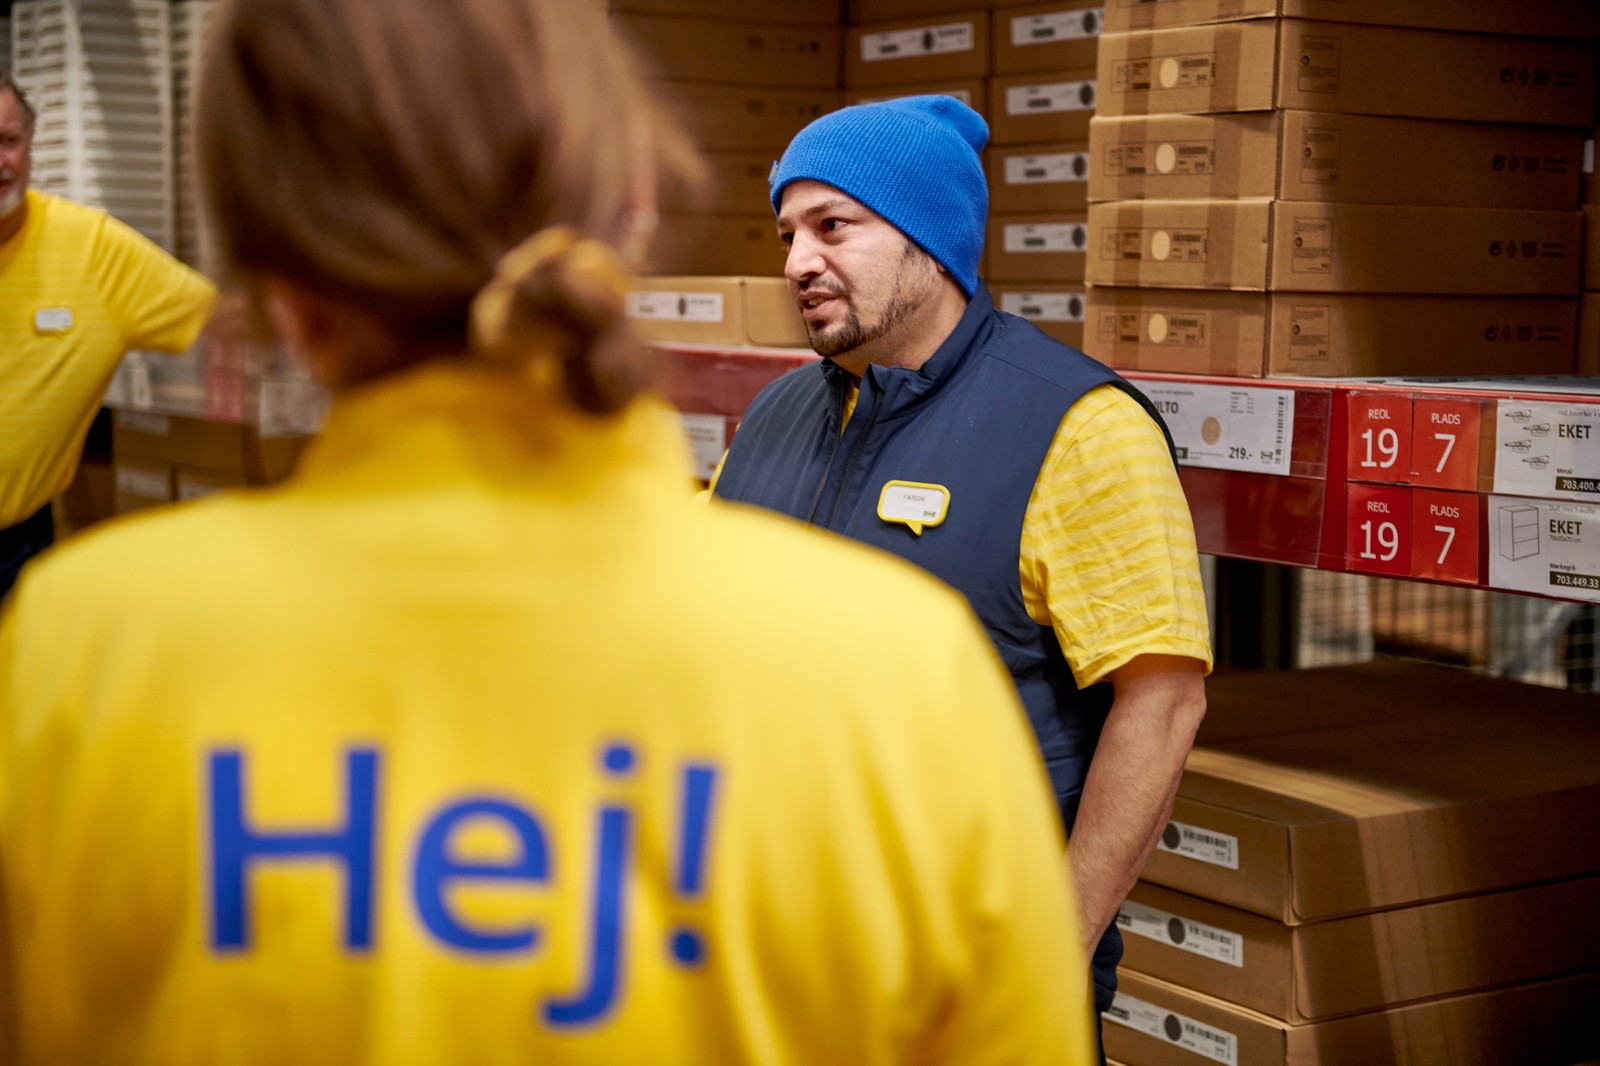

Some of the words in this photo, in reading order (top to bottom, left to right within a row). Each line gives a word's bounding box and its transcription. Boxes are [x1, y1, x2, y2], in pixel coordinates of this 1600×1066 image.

[1368, 408, 1391, 420] REOL
[1431, 412, 1461, 425] PLADS
[1559, 423, 1592, 439] EKET
[1229, 446, 1252, 460] 219.-
[1361, 428, 1399, 469] 19
[1434, 433, 1456, 473] 7
[1367, 501, 1391, 514] REOL
[1430, 504, 1460, 518] PLADS
[1549, 519, 1582, 535] EKET
[1360, 520, 1399, 562] 19
[1434, 525, 1456, 565] 7
[1556, 574, 1599, 588] 703.449.33
[209, 737, 721, 1030] Hej!
